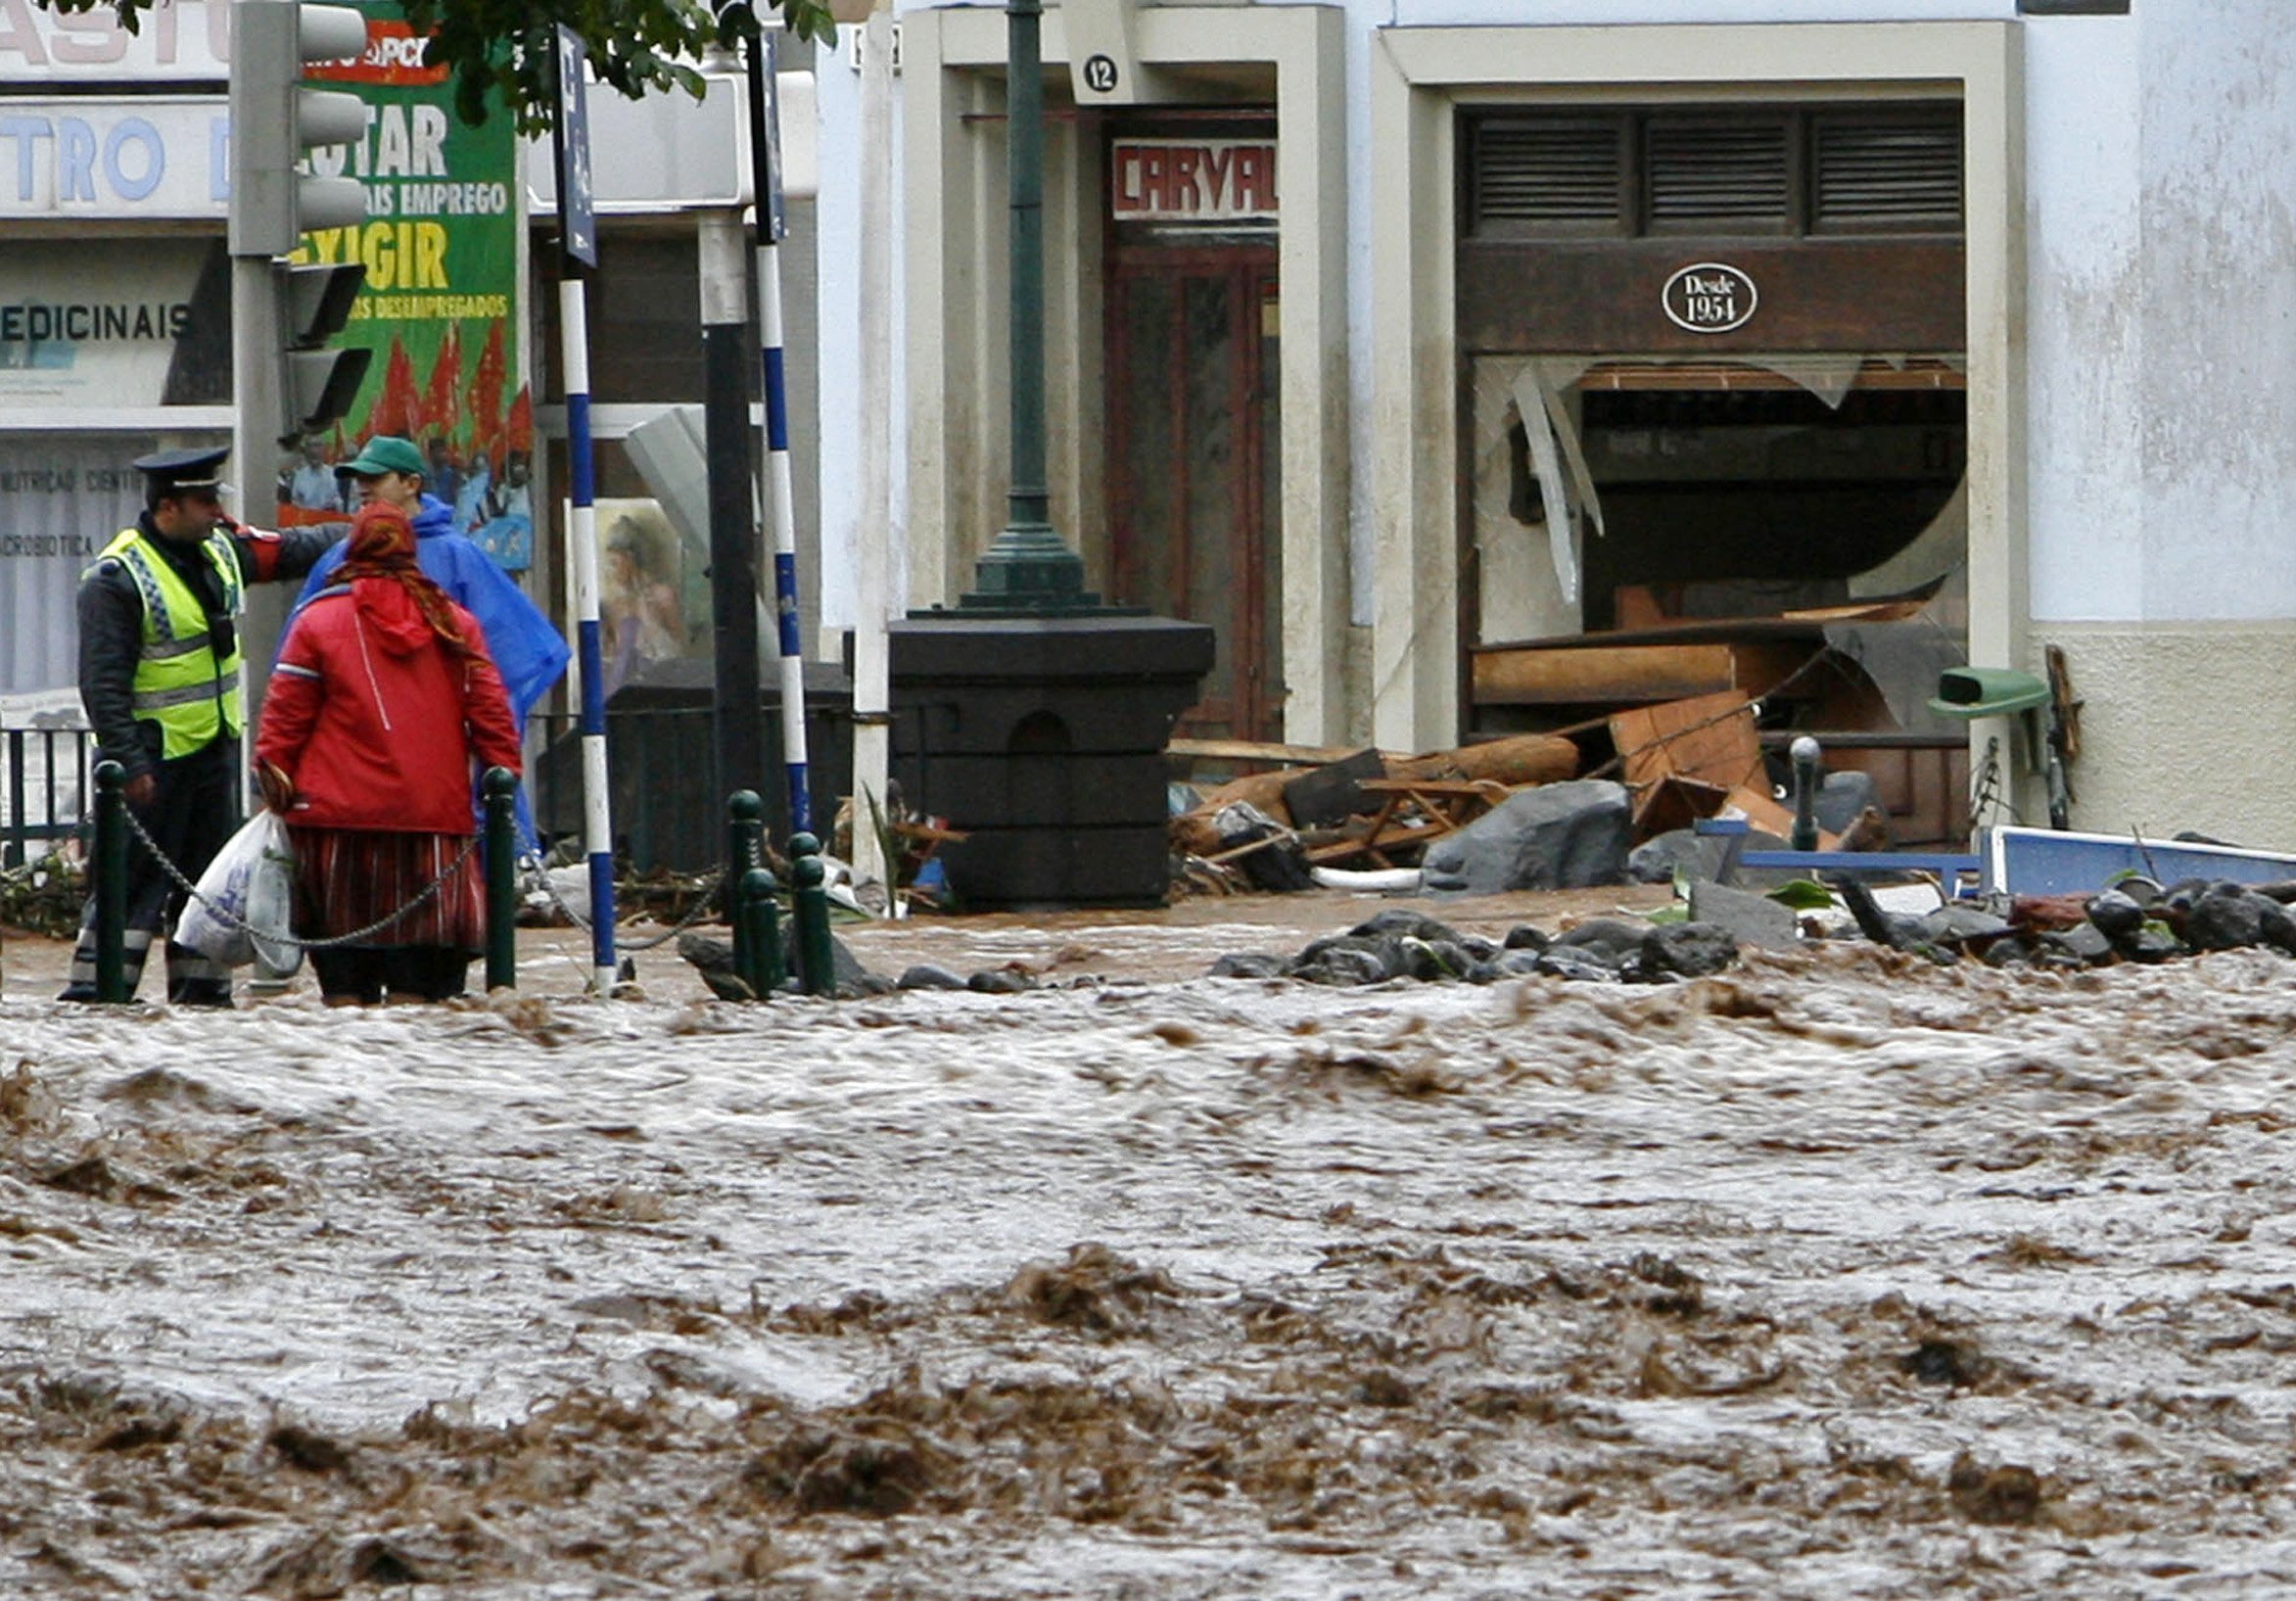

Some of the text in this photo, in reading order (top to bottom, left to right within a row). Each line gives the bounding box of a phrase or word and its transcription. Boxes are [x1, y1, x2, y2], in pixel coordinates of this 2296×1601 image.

[1090, 60, 1113, 87] 12
[399, 182, 508, 215] EMPREGO
[1684, 274, 1736, 297] Desde
[375, 294, 508, 320] DESEMPREGADOS
[1685, 297, 1737, 324] 1954
[1, 304, 193, 341] EDICINAIS
